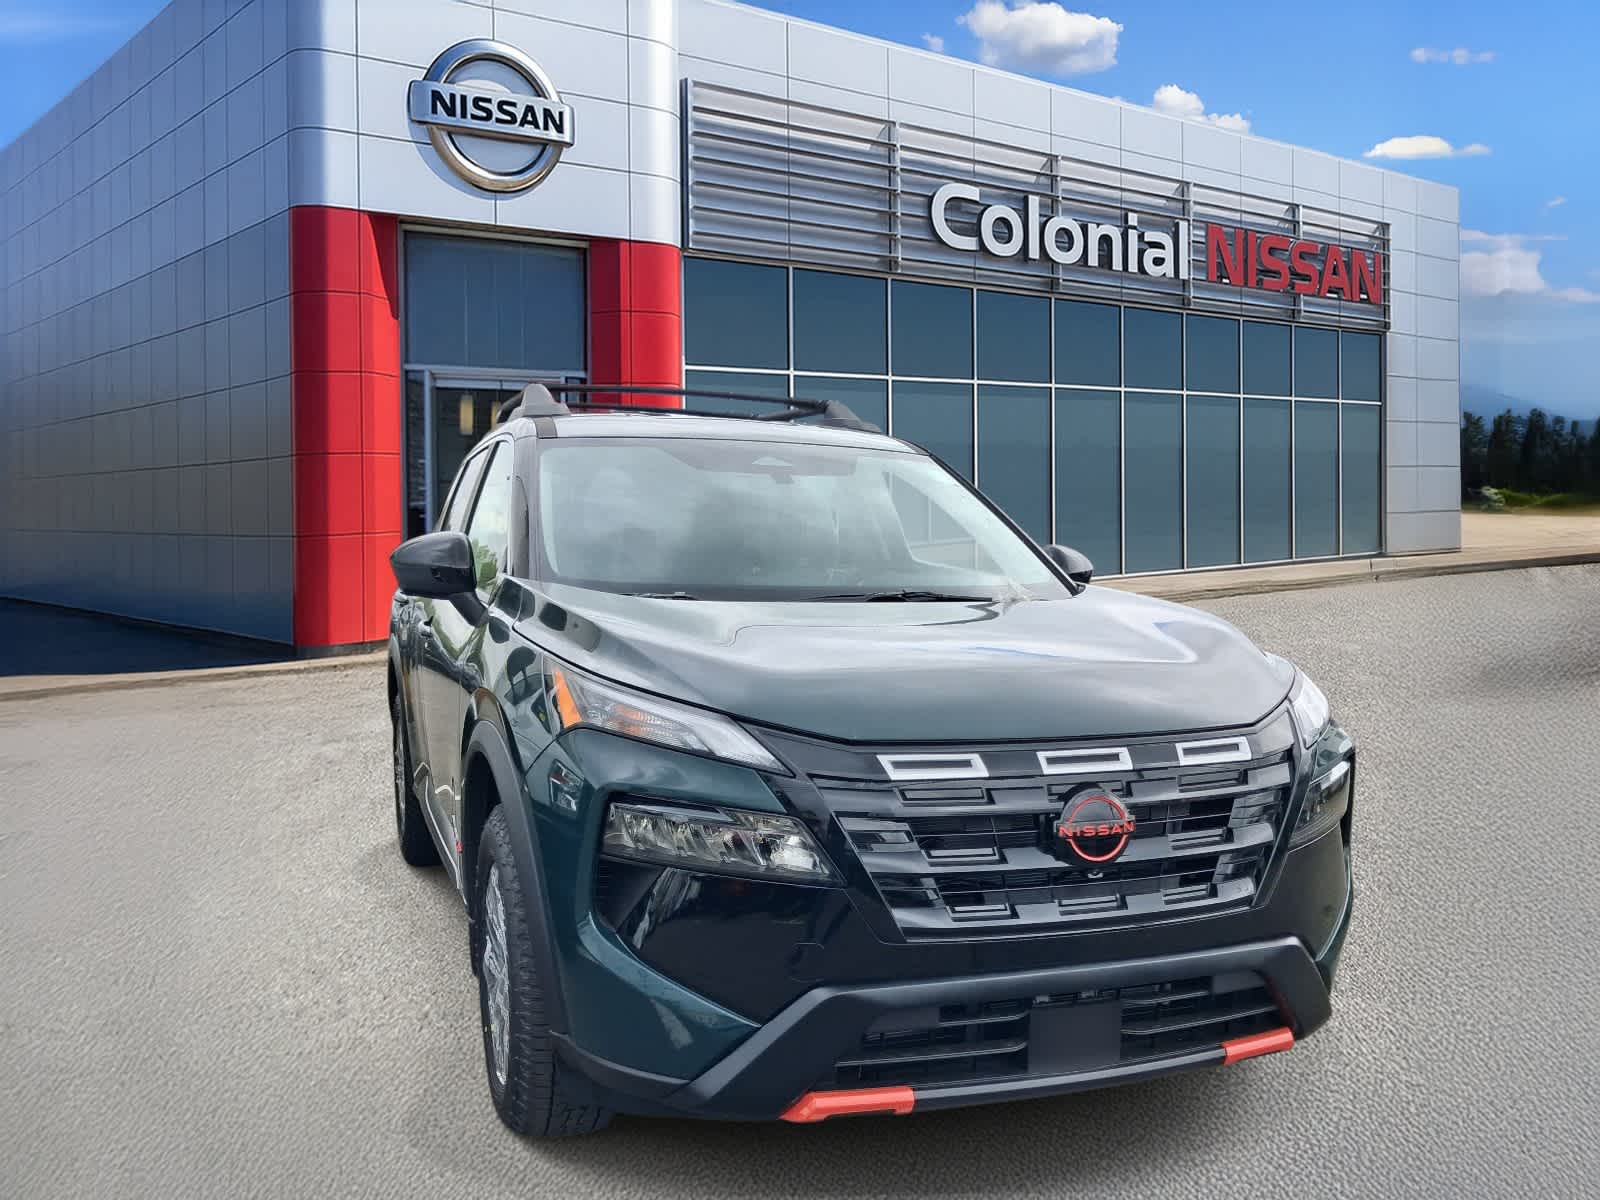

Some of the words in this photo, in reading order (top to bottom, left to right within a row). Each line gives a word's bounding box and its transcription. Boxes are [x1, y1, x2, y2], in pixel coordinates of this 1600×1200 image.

[430, 89, 564, 134] NISSAN
[930, 182, 1189, 280] Colonial
[1205, 223, 1383, 305] NISSAN
[1058, 821, 1135, 838] NISSAN
